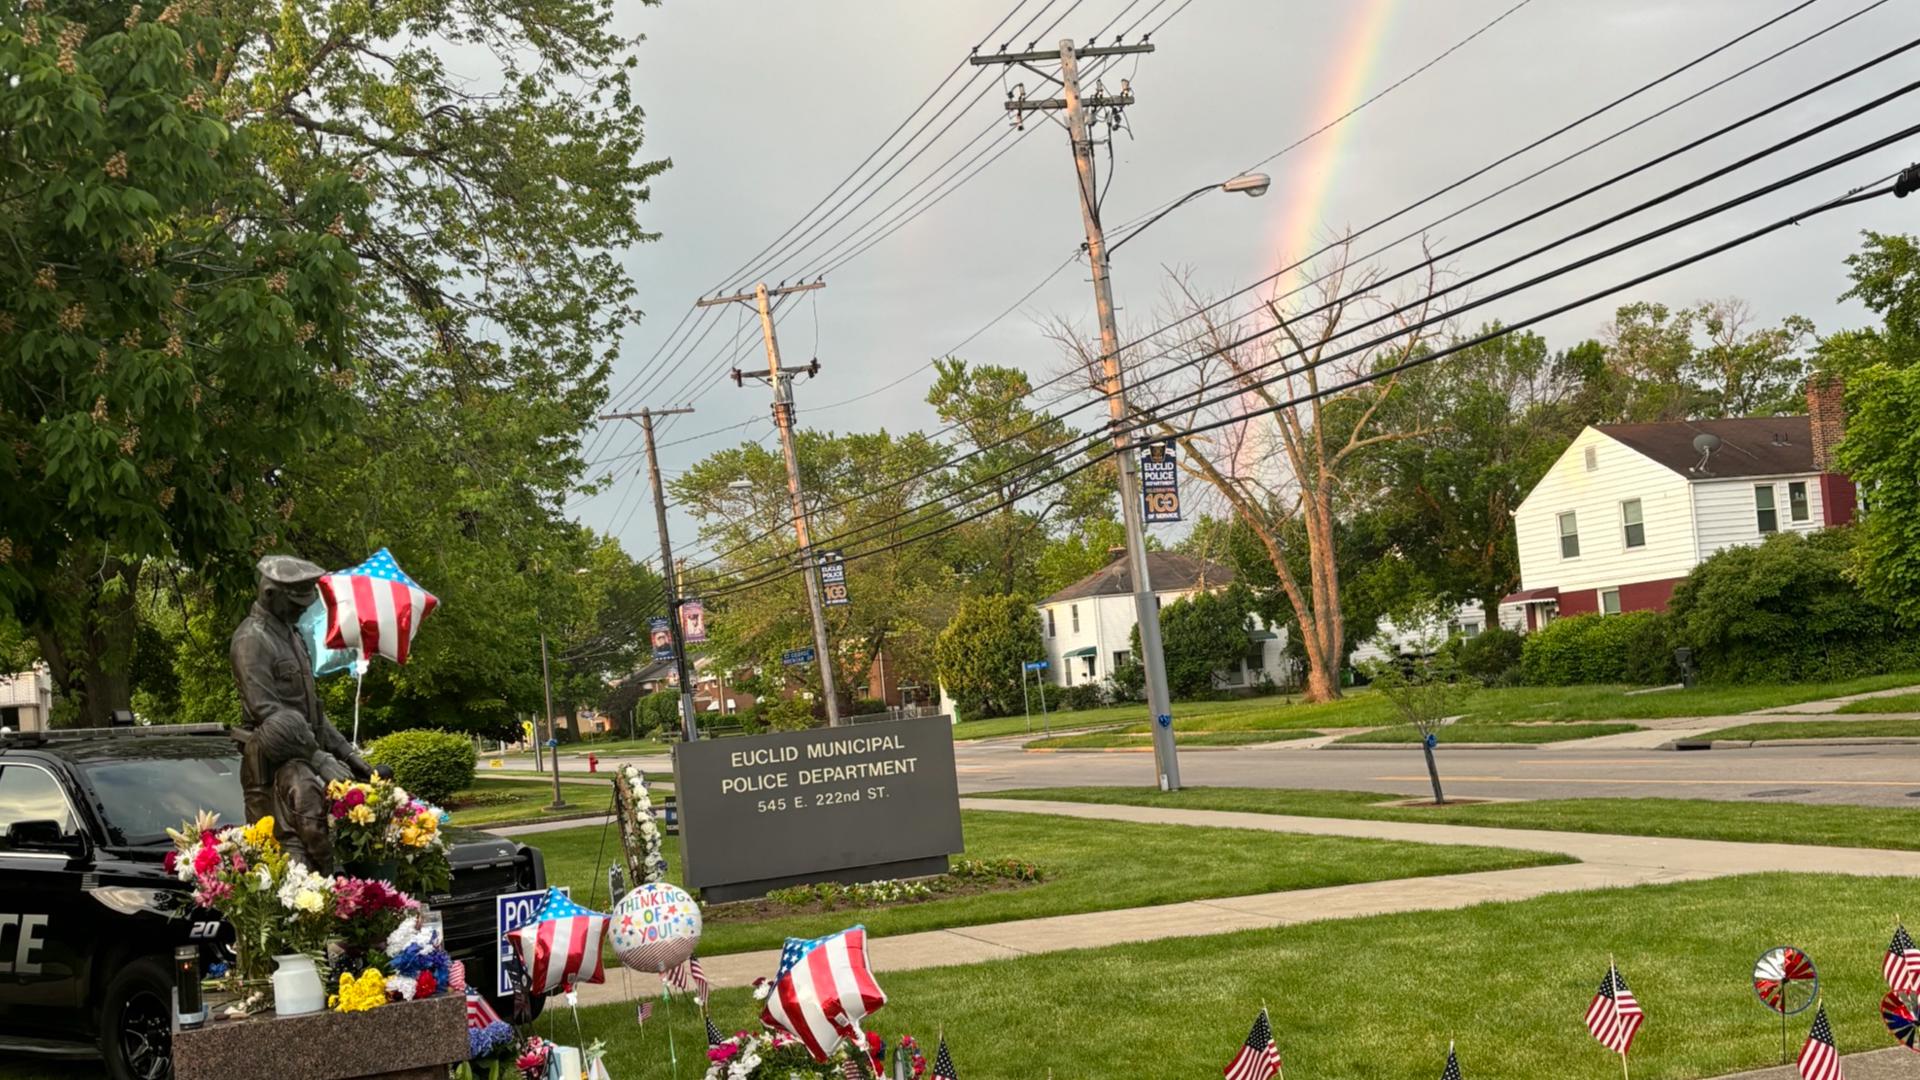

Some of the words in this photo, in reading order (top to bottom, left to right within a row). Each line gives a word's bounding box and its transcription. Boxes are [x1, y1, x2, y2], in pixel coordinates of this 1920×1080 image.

[1144, 463, 1174, 471] EUCLID
[1145, 472, 1174, 480] POLICE
[1146, 493, 1178, 512] 100
[731, 746, 799, 768] EUCLID
[807, 735, 905, 759] MUNICIPAL
[722, 773, 788, 794] POLICE
[799, 757, 918, 786] DEPARTMENT
[757, 799, 786, 813] 545
[795, 796, 808, 809] E.
[816, 789, 860, 806] 222nd
[867, 786, 890, 800] ST.
[620, 891, 686, 915] THINKING
[644, 907, 662, 924] OF
[189, 921, 220, 938] 20
[639, 922, 672, 944] YOU!
